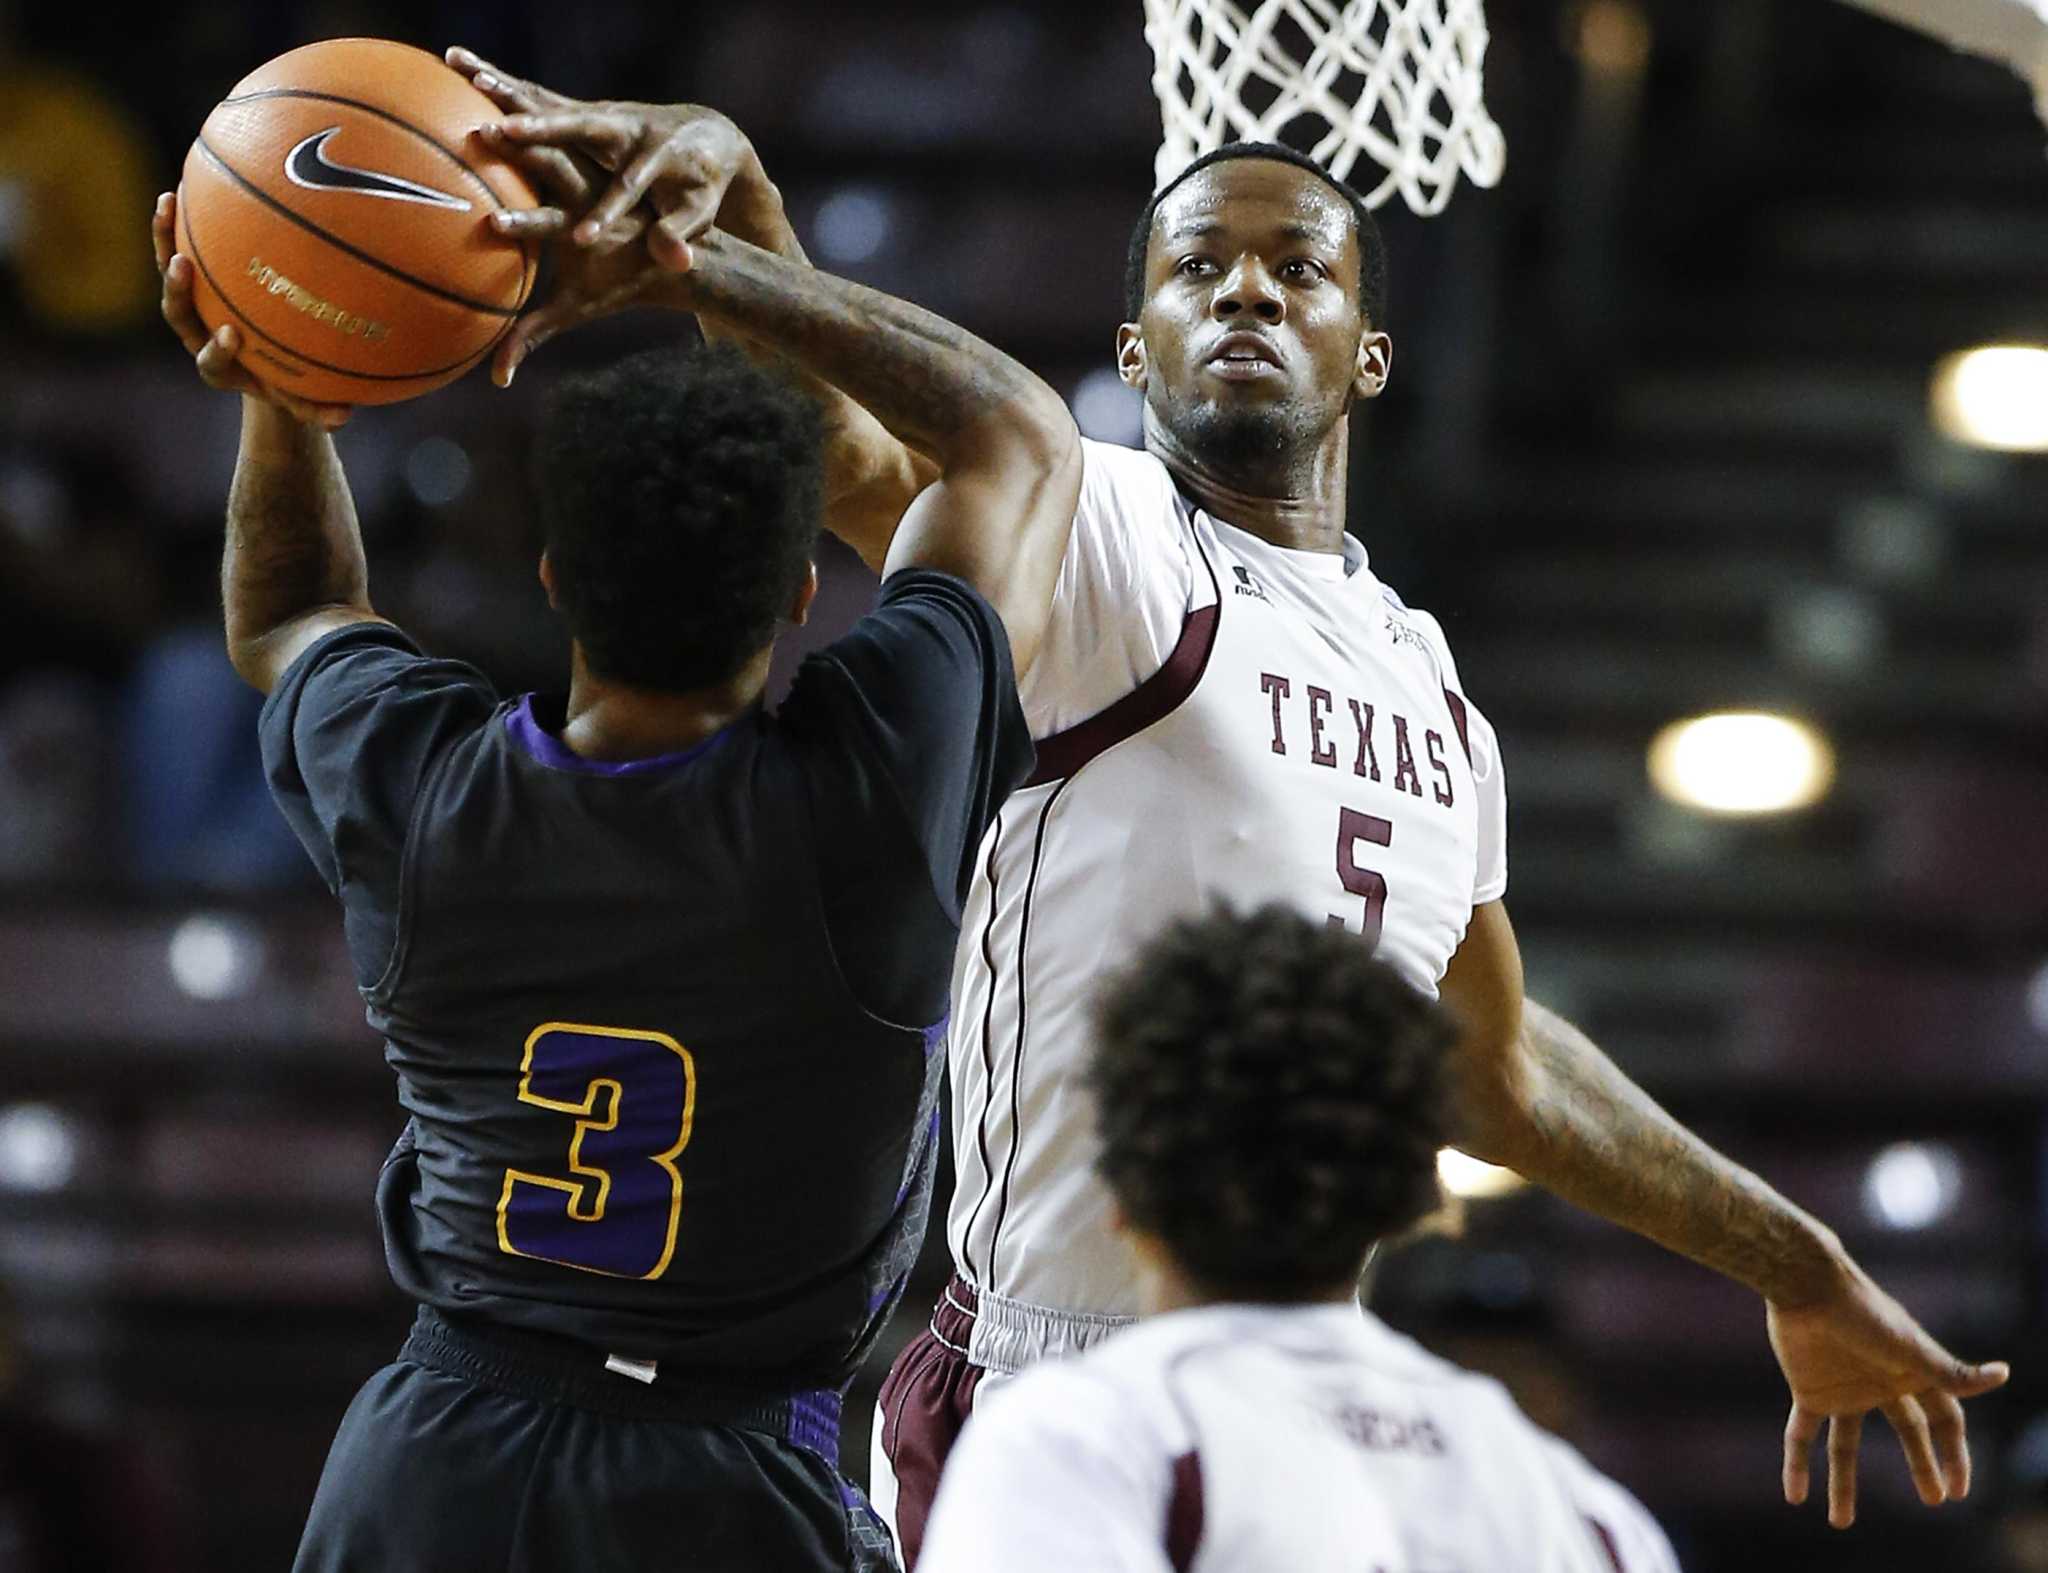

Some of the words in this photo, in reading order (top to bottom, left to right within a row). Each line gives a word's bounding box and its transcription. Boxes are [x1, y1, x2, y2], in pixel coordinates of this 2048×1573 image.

[1261, 672, 1454, 808] TEXAS
[1326, 806, 1392, 945] 5
[496, 1022, 696, 1280] 3
